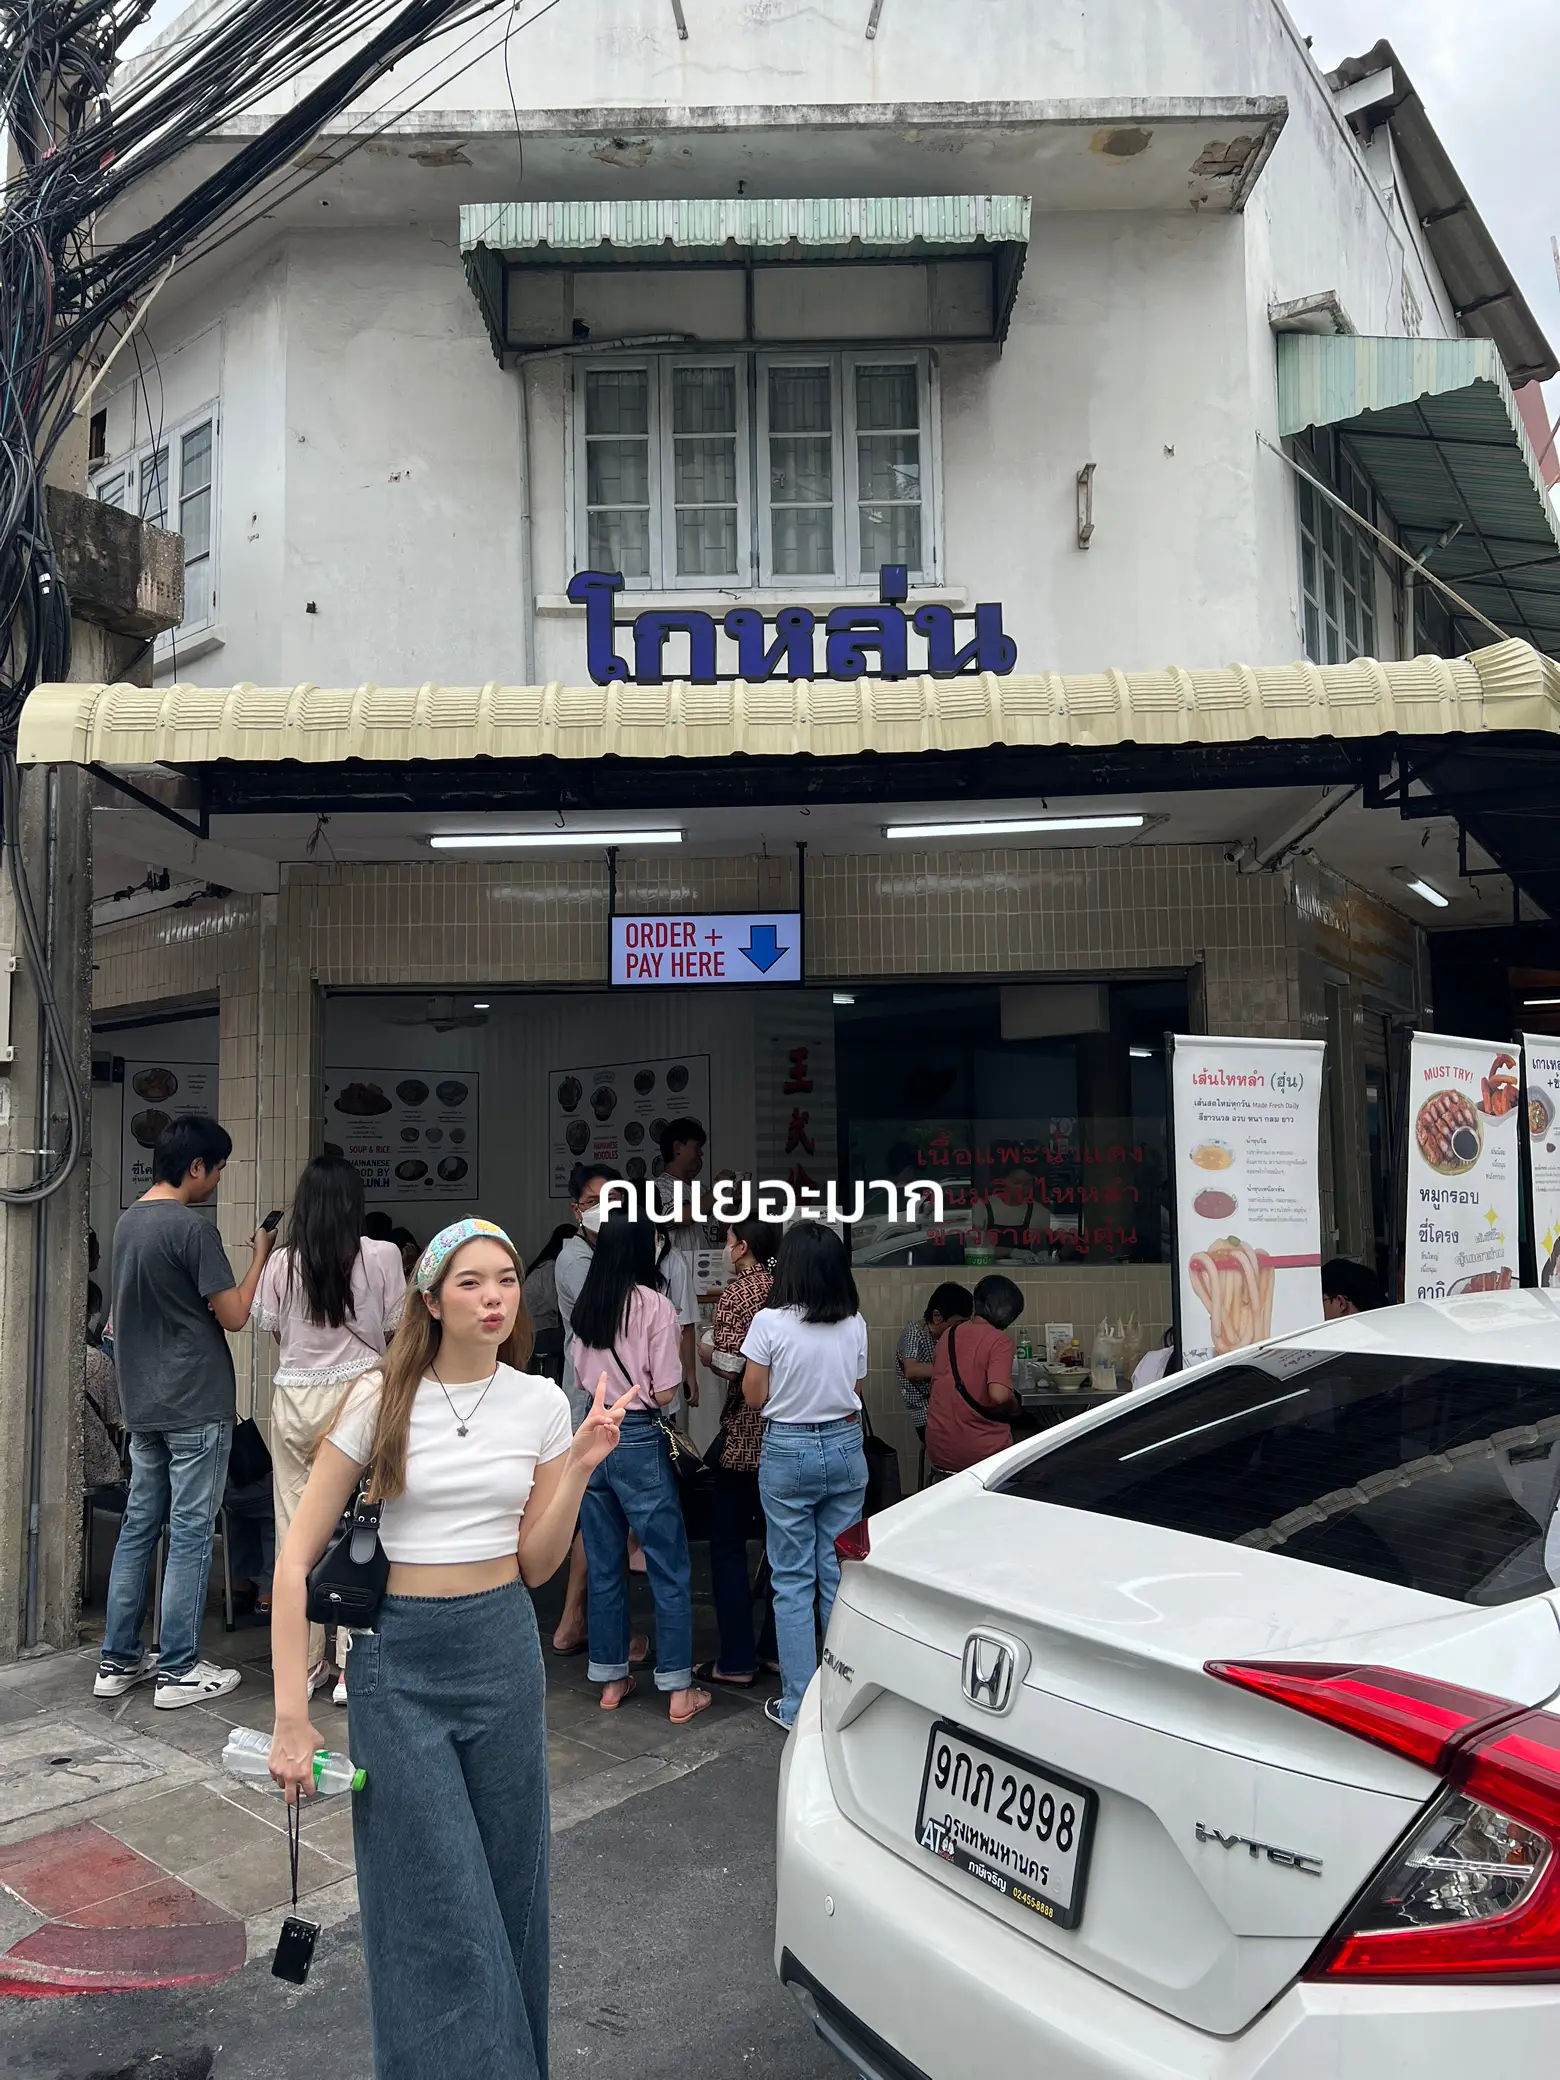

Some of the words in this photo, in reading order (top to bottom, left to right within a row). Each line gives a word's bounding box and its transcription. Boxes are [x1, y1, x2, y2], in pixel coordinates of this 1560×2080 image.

[566, 563, 1018, 686] โกหล่น
[625, 922, 697, 949] ORDER
[704, 928, 723, 947] +
[626, 952, 664, 979] PAY
[671, 951, 726, 978] HERE
[1192, 1067, 1265, 1087] เส้นไหหลำ
[1423, 1065, 1451, 1082] MUST
[1453, 1066, 1474, 1084] TRY!
[1252, 1101, 1268, 1109] Made
[1285, 1102, 1300, 1110] Daily
[349, 1146, 368, 1154] SOUP
[375, 1146, 391, 1154] RICE
[916, 1131, 1144, 1169] เนื้อแพะน้ำแดง
[132, 1160, 153, 1175] ซี่โค
[377, 1168, 390, 1177] BY
[922, 1174, 1139, 1205] ขนมจีนไหหลำ
[1419, 1188, 1479, 1211] หมูกรอบ
[926, 1217, 1139, 1254] ข้าวราดหมูตุ๋น
[1418, 1218, 1459, 1244] ซี่โครง
[1417, 1280, 1446, 1299] คากิ
[934, 1744, 994, 1814] 9กภ
[996, 1775, 1076, 1852] 2998
[920, 1820, 946, 1854] AT
[968, 1861, 1007, 1893] ภาษีเจริญ
[1012, 1886, 1054, 1919] 02-455-8888
